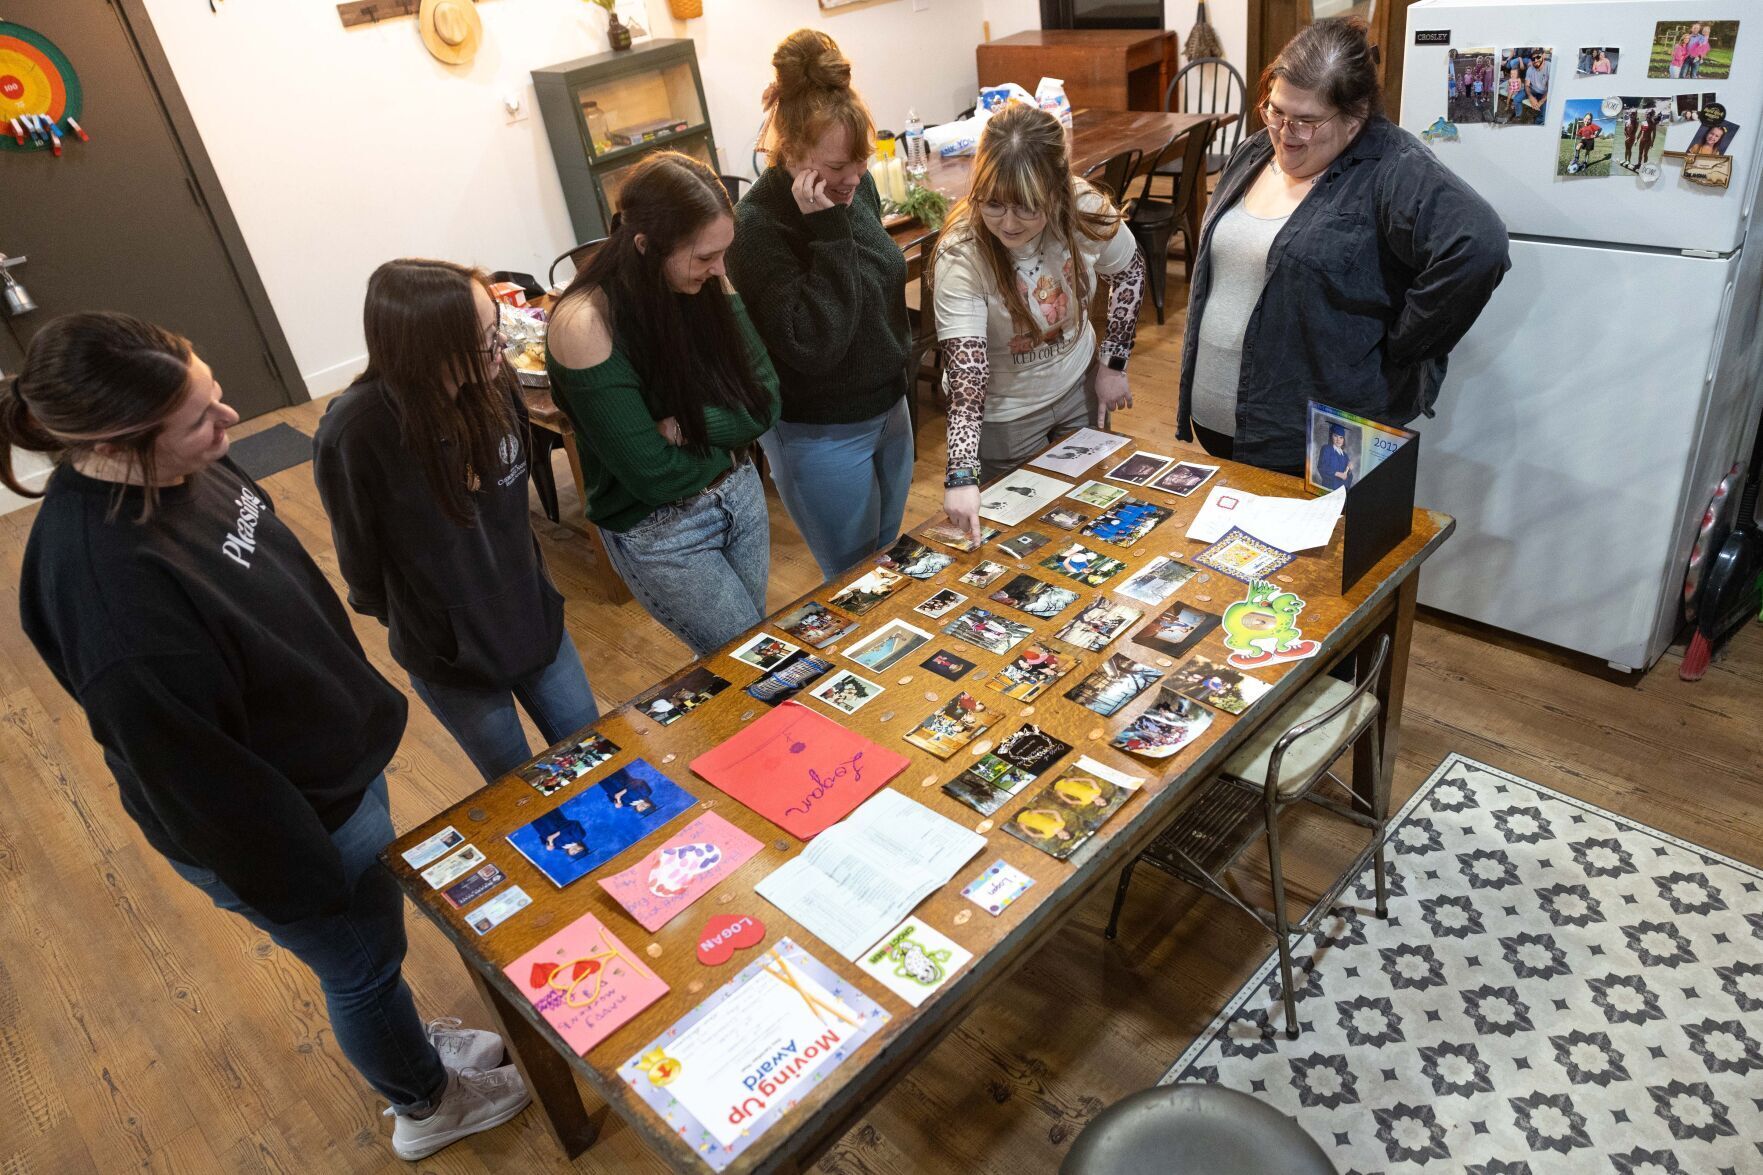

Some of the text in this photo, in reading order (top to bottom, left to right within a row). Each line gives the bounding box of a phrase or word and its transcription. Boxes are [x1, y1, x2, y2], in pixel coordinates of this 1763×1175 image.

[1417, 32, 1449, 42] CROSLEY
[4, 83, 18, 92] 100
[35, 139, 44, 147] 10
[1012, 350, 1036, 365] ICED
[1374, 437, 1398, 453] 2012
[222, 485, 267, 569] Pleasing
[785, 751, 863, 817] Logan
[700, 916, 753, 953] LOGAN
[742, 1039, 798, 1092] Award
[757, 1029, 841, 1101] Moving
[728, 1096, 767, 1125] Up
